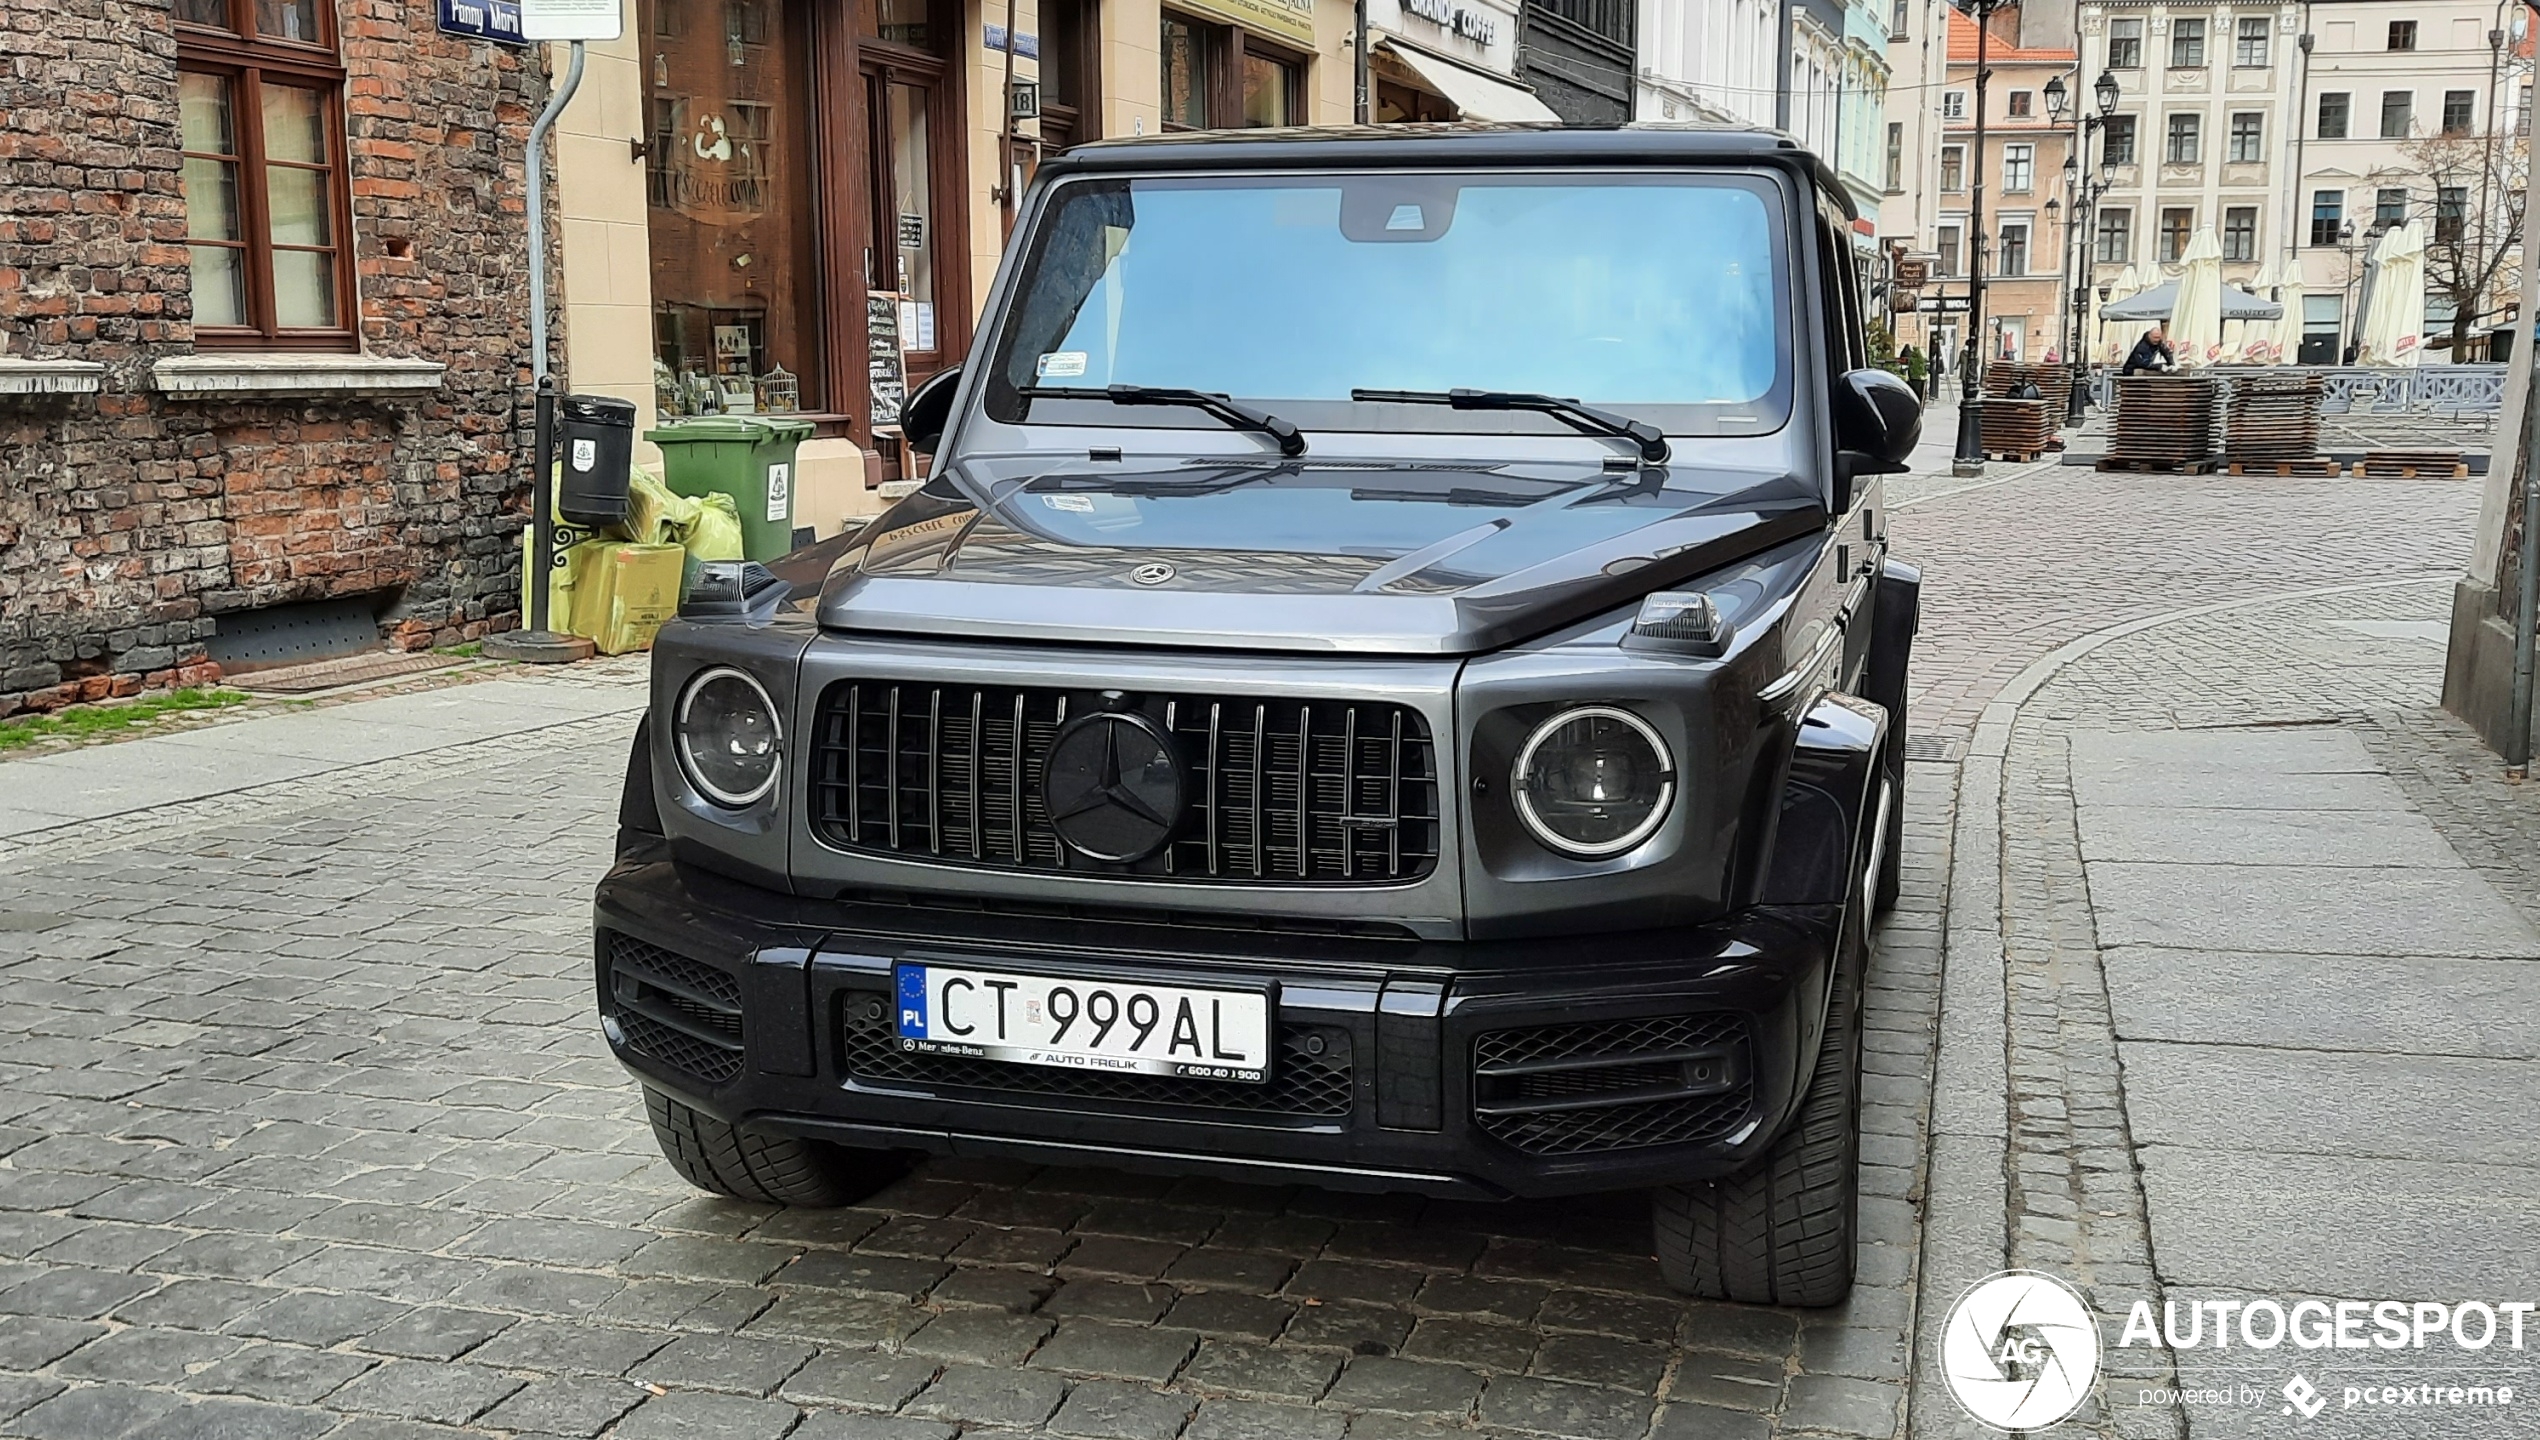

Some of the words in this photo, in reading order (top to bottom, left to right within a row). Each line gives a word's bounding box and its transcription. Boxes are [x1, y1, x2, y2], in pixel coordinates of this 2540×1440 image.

[451, 0, 484, 33] Panny
[489, 3, 519, 34] Marii
[1012, 93, 1030, 111] 18
[903, 1009, 924, 1028] PL
[942, 977, 1018, 1039] CT
[1048, 986, 1246, 1062] 999AL
[918, 1042, 984, 1056] Meredes-Benz
[1045, 1054, 1085, 1066] AUTO
[1090, 1057, 1138, 1070] FRELIK
[1188, 1066, 1211, 1077] 600
[1237, 1070, 1261, 1081] 900
